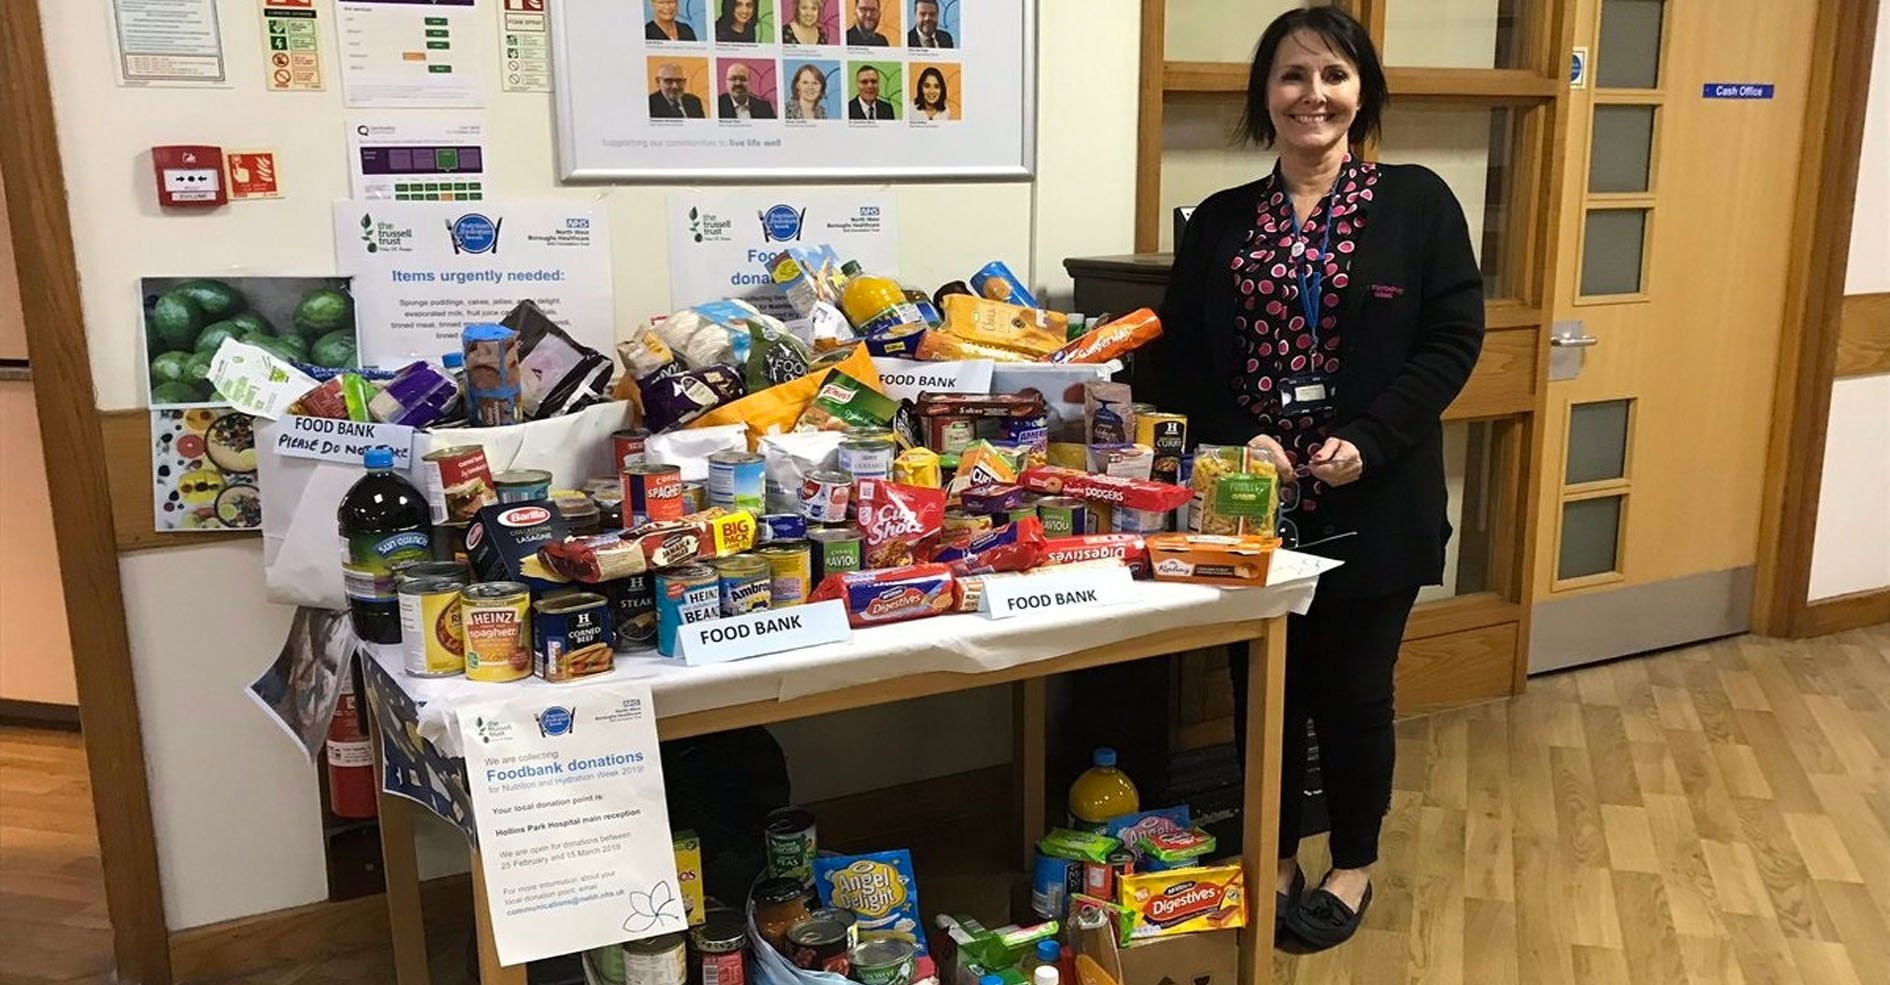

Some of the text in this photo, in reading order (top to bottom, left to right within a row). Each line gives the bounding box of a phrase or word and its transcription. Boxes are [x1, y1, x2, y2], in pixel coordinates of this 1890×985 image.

[1715, 85, 1764, 97] Cash Office
[729, 138, 745, 147] live
[747, 138, 761, 147] life
[763, 138, 782, 147] well
[860, 207, 880, 215] NHS
[566, 219, 590, 228] NHS
[378, 229, 413, 238] trussell
[378, 238, 401, 246] trust
[392, 269, 565, 284] Items urgently needed:
[400, 299, 428, 308] Sponge
[391, 321, 415, 329] tinned
[879, 374, 957, 388] FOOD BANK
[295, 417, 376, 438] FOOD BANK
[1085, 487, 1124, 501] DODGERS
[510, 510, 548, 523] Barilla
[721, 519, 749, 537] BIG
[723, 532, 749, 546] PACK
[1048, 547, 1126, 562] Digestives
[730, 582, 770, 602] Ambro
[620, 598, 653, 608] STEAK
[872, 593, 921, 615] Digestives
[1007, 589, 1097, 611] FOOD BANK
[473, 611, 515, 624] HEINZ
[578, 613, 590, 624] H
[684, 606, 719, 624] BEAN
[568, 626, 602, 639] CORNED
[699, 614, 803, 645] FOOD BANK
[576, 634, 594, 644] BEEF
[485, 750, 559, 765] We are collecting
[487, 751, 644, 782] Foodbank donations
[488, 785, 500, 793] for
[502, 781, 536, 793] Nutrition
[538, 778, 552, 787] and
[555, 773, 595, 787] Hydration
[597, 769, 619, 778] Week
[492, 806, 512, 815] Your
[514, 803, 534, 813] local
[536, 799, 571, 810] donation
[572, 795, 593, 806] point
[495, 808, 641, 838] Hollins Park Hospital main reception
[499, 831, 632, 859] We are open for donations between
[513, 856, 549, 868] February
[551, 853, 565, 862] and
[577, 847, 601, 858] March
[837, 867, 891, 895] Angel
[841, 885, 896, 911] Delight
[1152, 886, 1217, 915] Digestives
